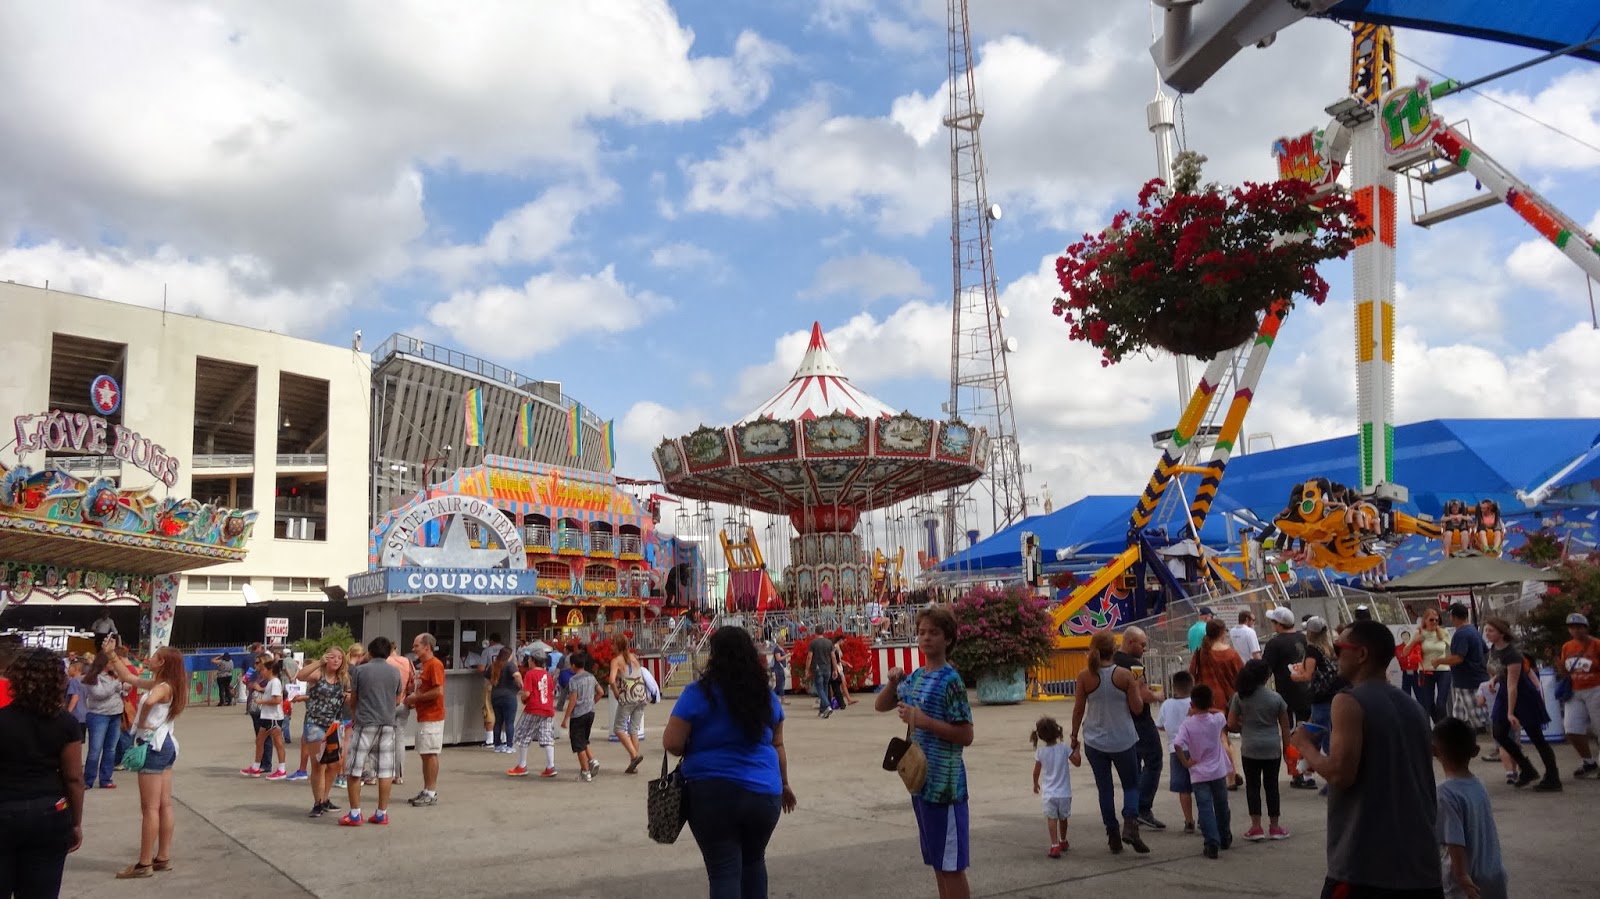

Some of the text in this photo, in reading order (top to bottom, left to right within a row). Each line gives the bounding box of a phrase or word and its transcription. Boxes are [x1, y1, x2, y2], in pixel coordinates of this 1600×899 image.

[14, 409, 181, 488] LOVE BUGS
[388, 497, 523, 555] STATE FAIR OF TEXAS
[351, 573, 385, 595] COUPONS
[407, 573, 519, 591] COUPONS
[267, 626, 288, 635] ENTRANCE
